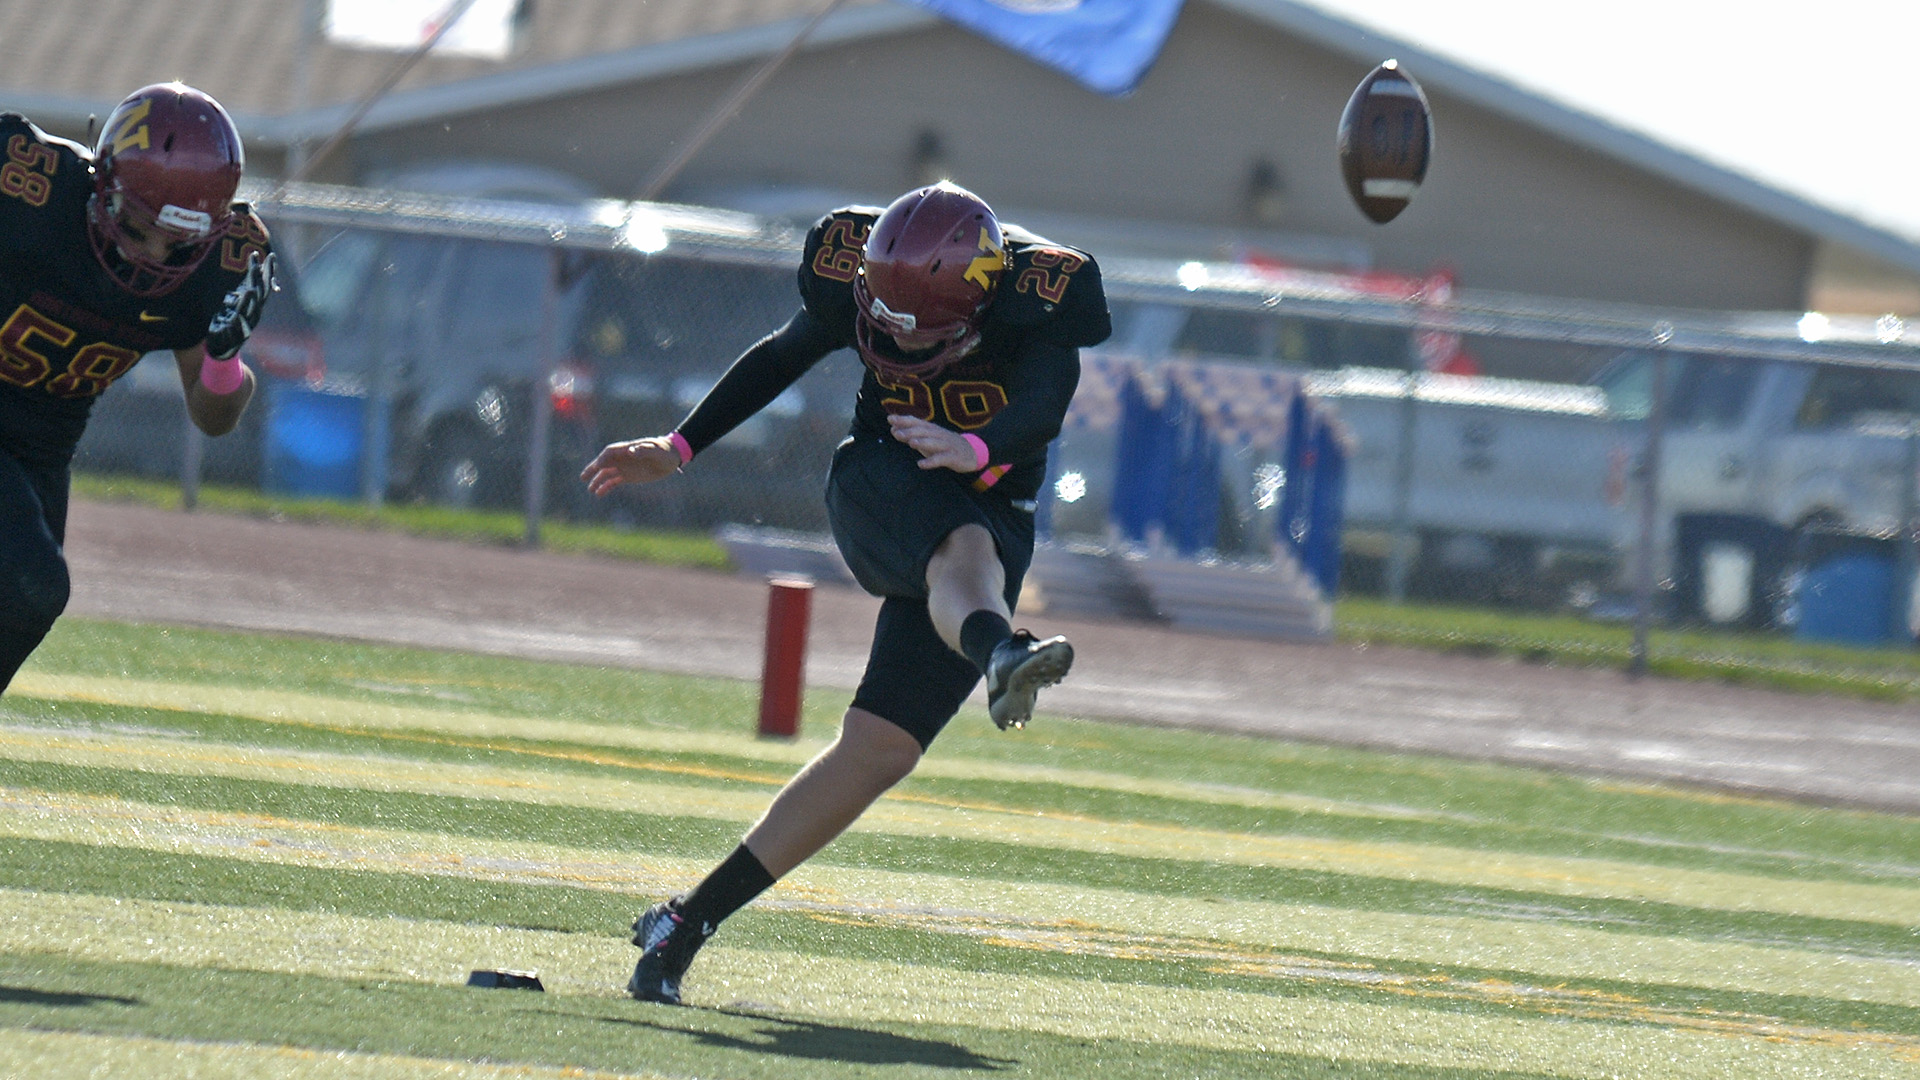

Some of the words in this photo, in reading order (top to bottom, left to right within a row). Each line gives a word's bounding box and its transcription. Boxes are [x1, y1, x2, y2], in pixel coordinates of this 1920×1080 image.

[0, 133, 59, 207] 58
[812, 219, 868, 283] 29
[963, 227, 1005, 292] N
[1016, 247, 1086, 304] 29
[0, 303, 140, 398] 58
